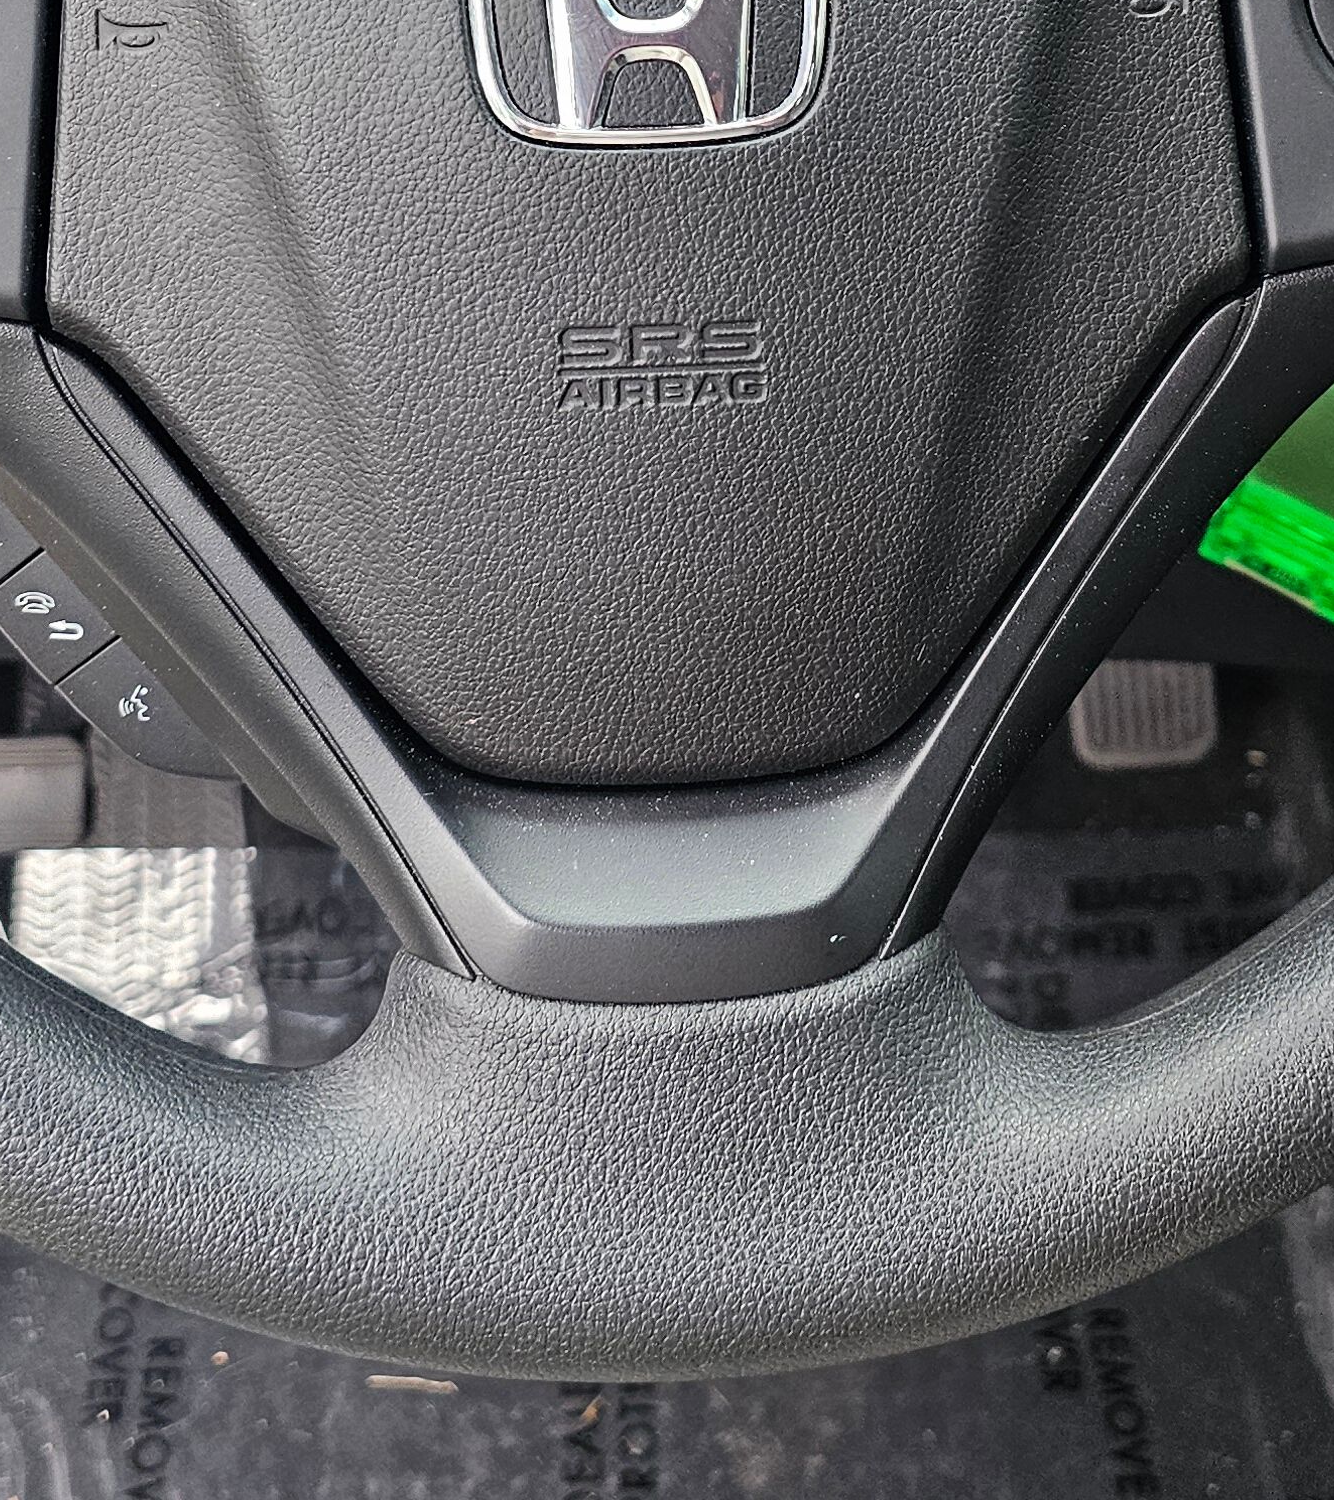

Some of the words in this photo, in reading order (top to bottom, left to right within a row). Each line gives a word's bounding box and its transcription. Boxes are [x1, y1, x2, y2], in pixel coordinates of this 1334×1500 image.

[557, 320, 764, 366] SRS
[557, 372, 769, 409] AIRBAG
[1036, 1306, 1087, 1395] VER
[121, 1333, 191, 1500] REMOV
